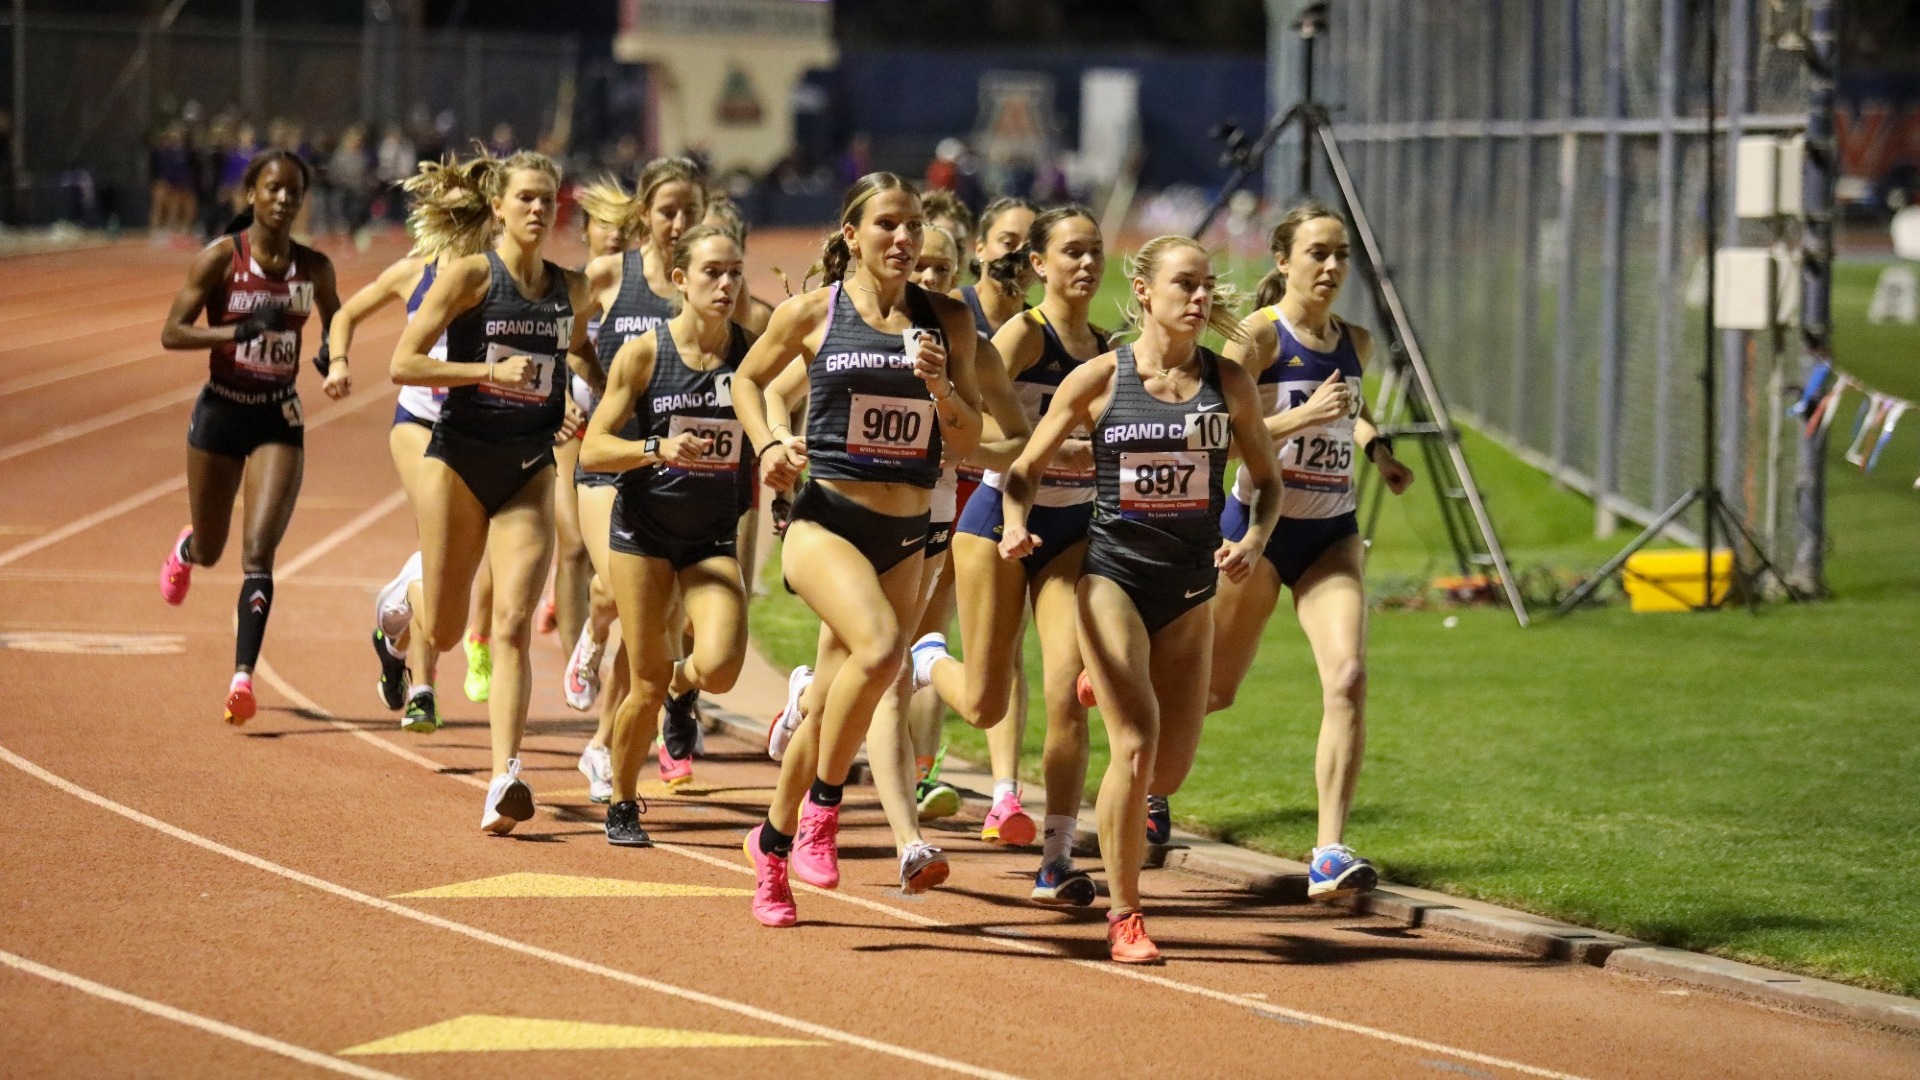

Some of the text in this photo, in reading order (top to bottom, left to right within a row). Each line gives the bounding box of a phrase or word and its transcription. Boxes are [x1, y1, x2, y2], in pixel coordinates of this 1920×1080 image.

[485, 320, 534, 336] GRAND
[614, 317, 662, 333] GRAND
[826, 352, 885, 372] GRAND
[653, 394, 702, 414] GRAND
[862, 408, 921, 442] 900
[1104, 423, 1165, 444] GRAND
[1194, 414, 1222, 447] 10
[1293, 436, 1351, 470] 1255
[1134, 464, 1195, 495] 897
